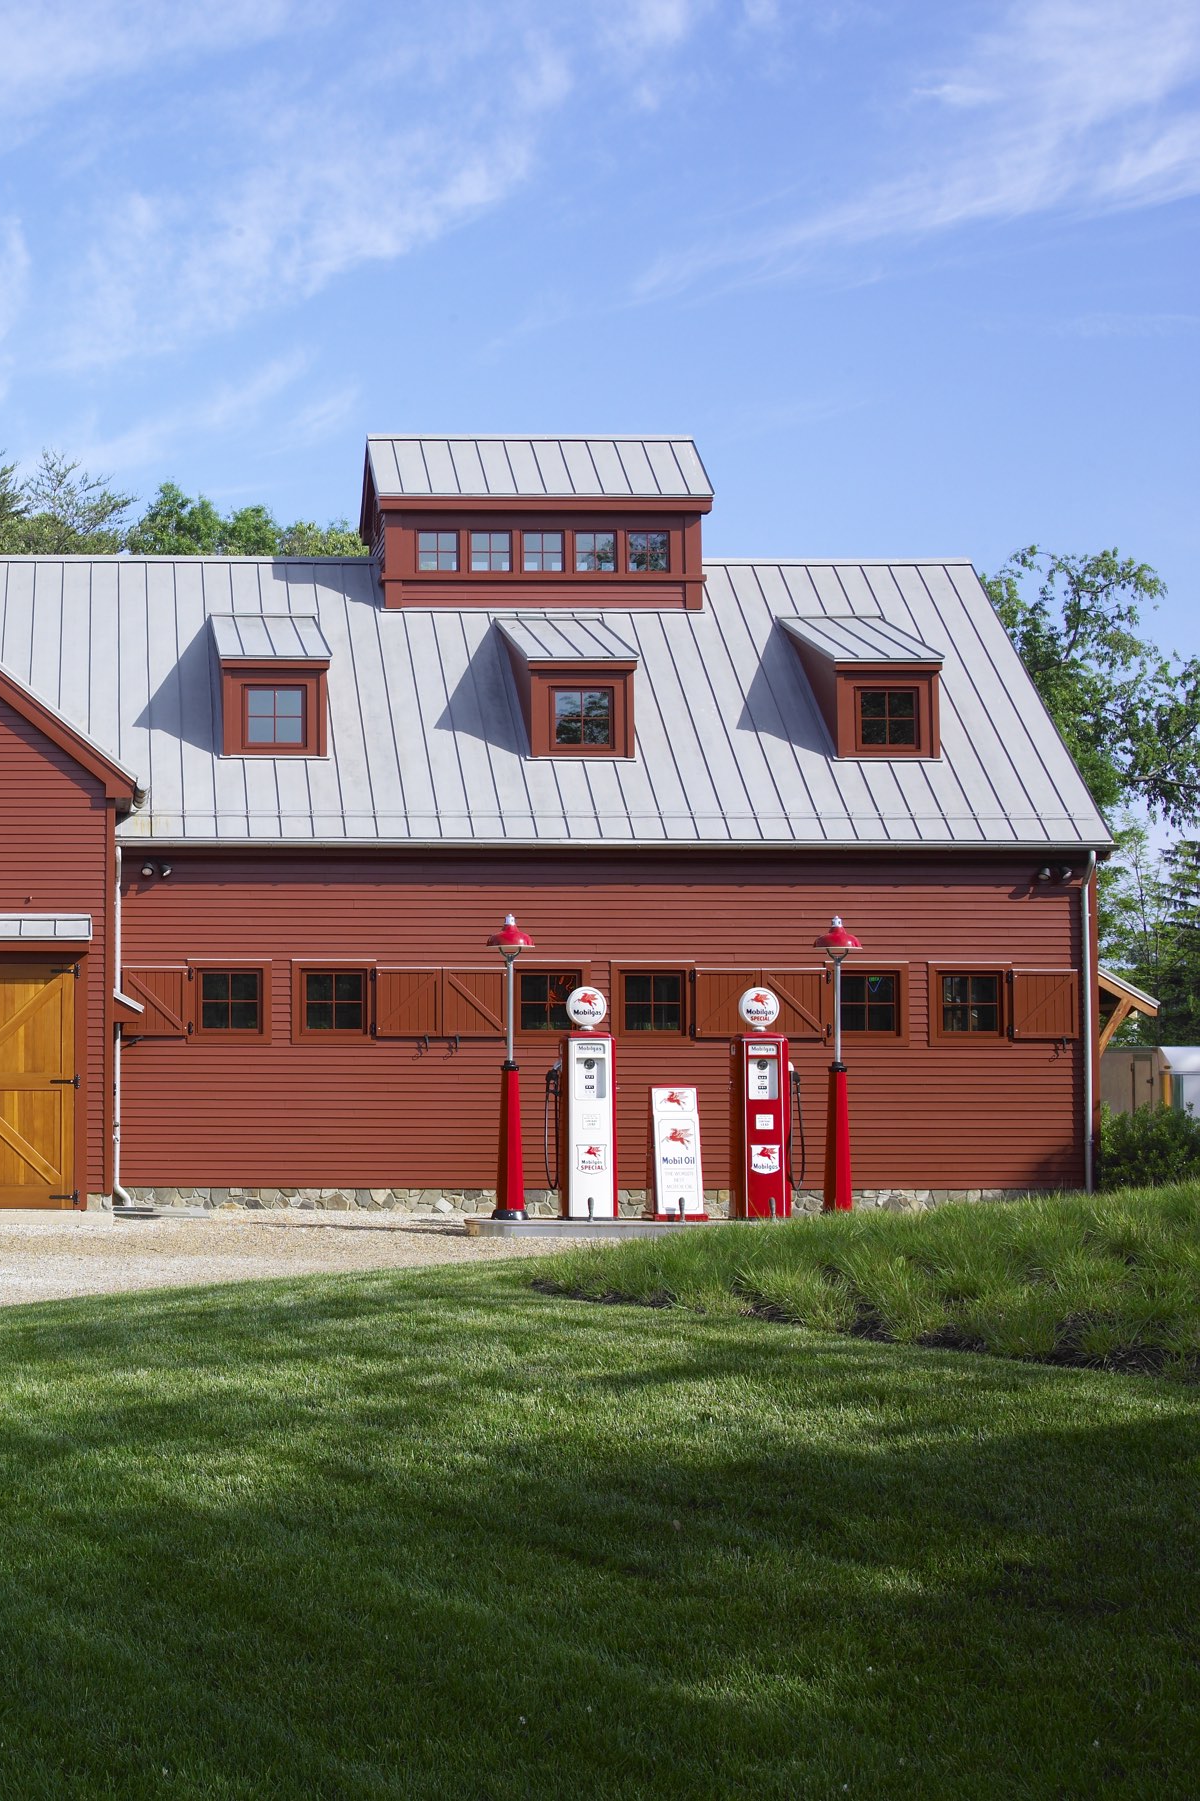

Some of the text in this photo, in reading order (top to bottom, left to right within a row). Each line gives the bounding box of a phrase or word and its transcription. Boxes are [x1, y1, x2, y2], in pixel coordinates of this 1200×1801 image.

[573, 1009, 602, 1017] Mobilgas
[746, 1009, 775, 1017] Mobilgas
[662, 1156, 695, 1164] Mobil Oil
[753, 1163, 779, 1171] Mobilgas
